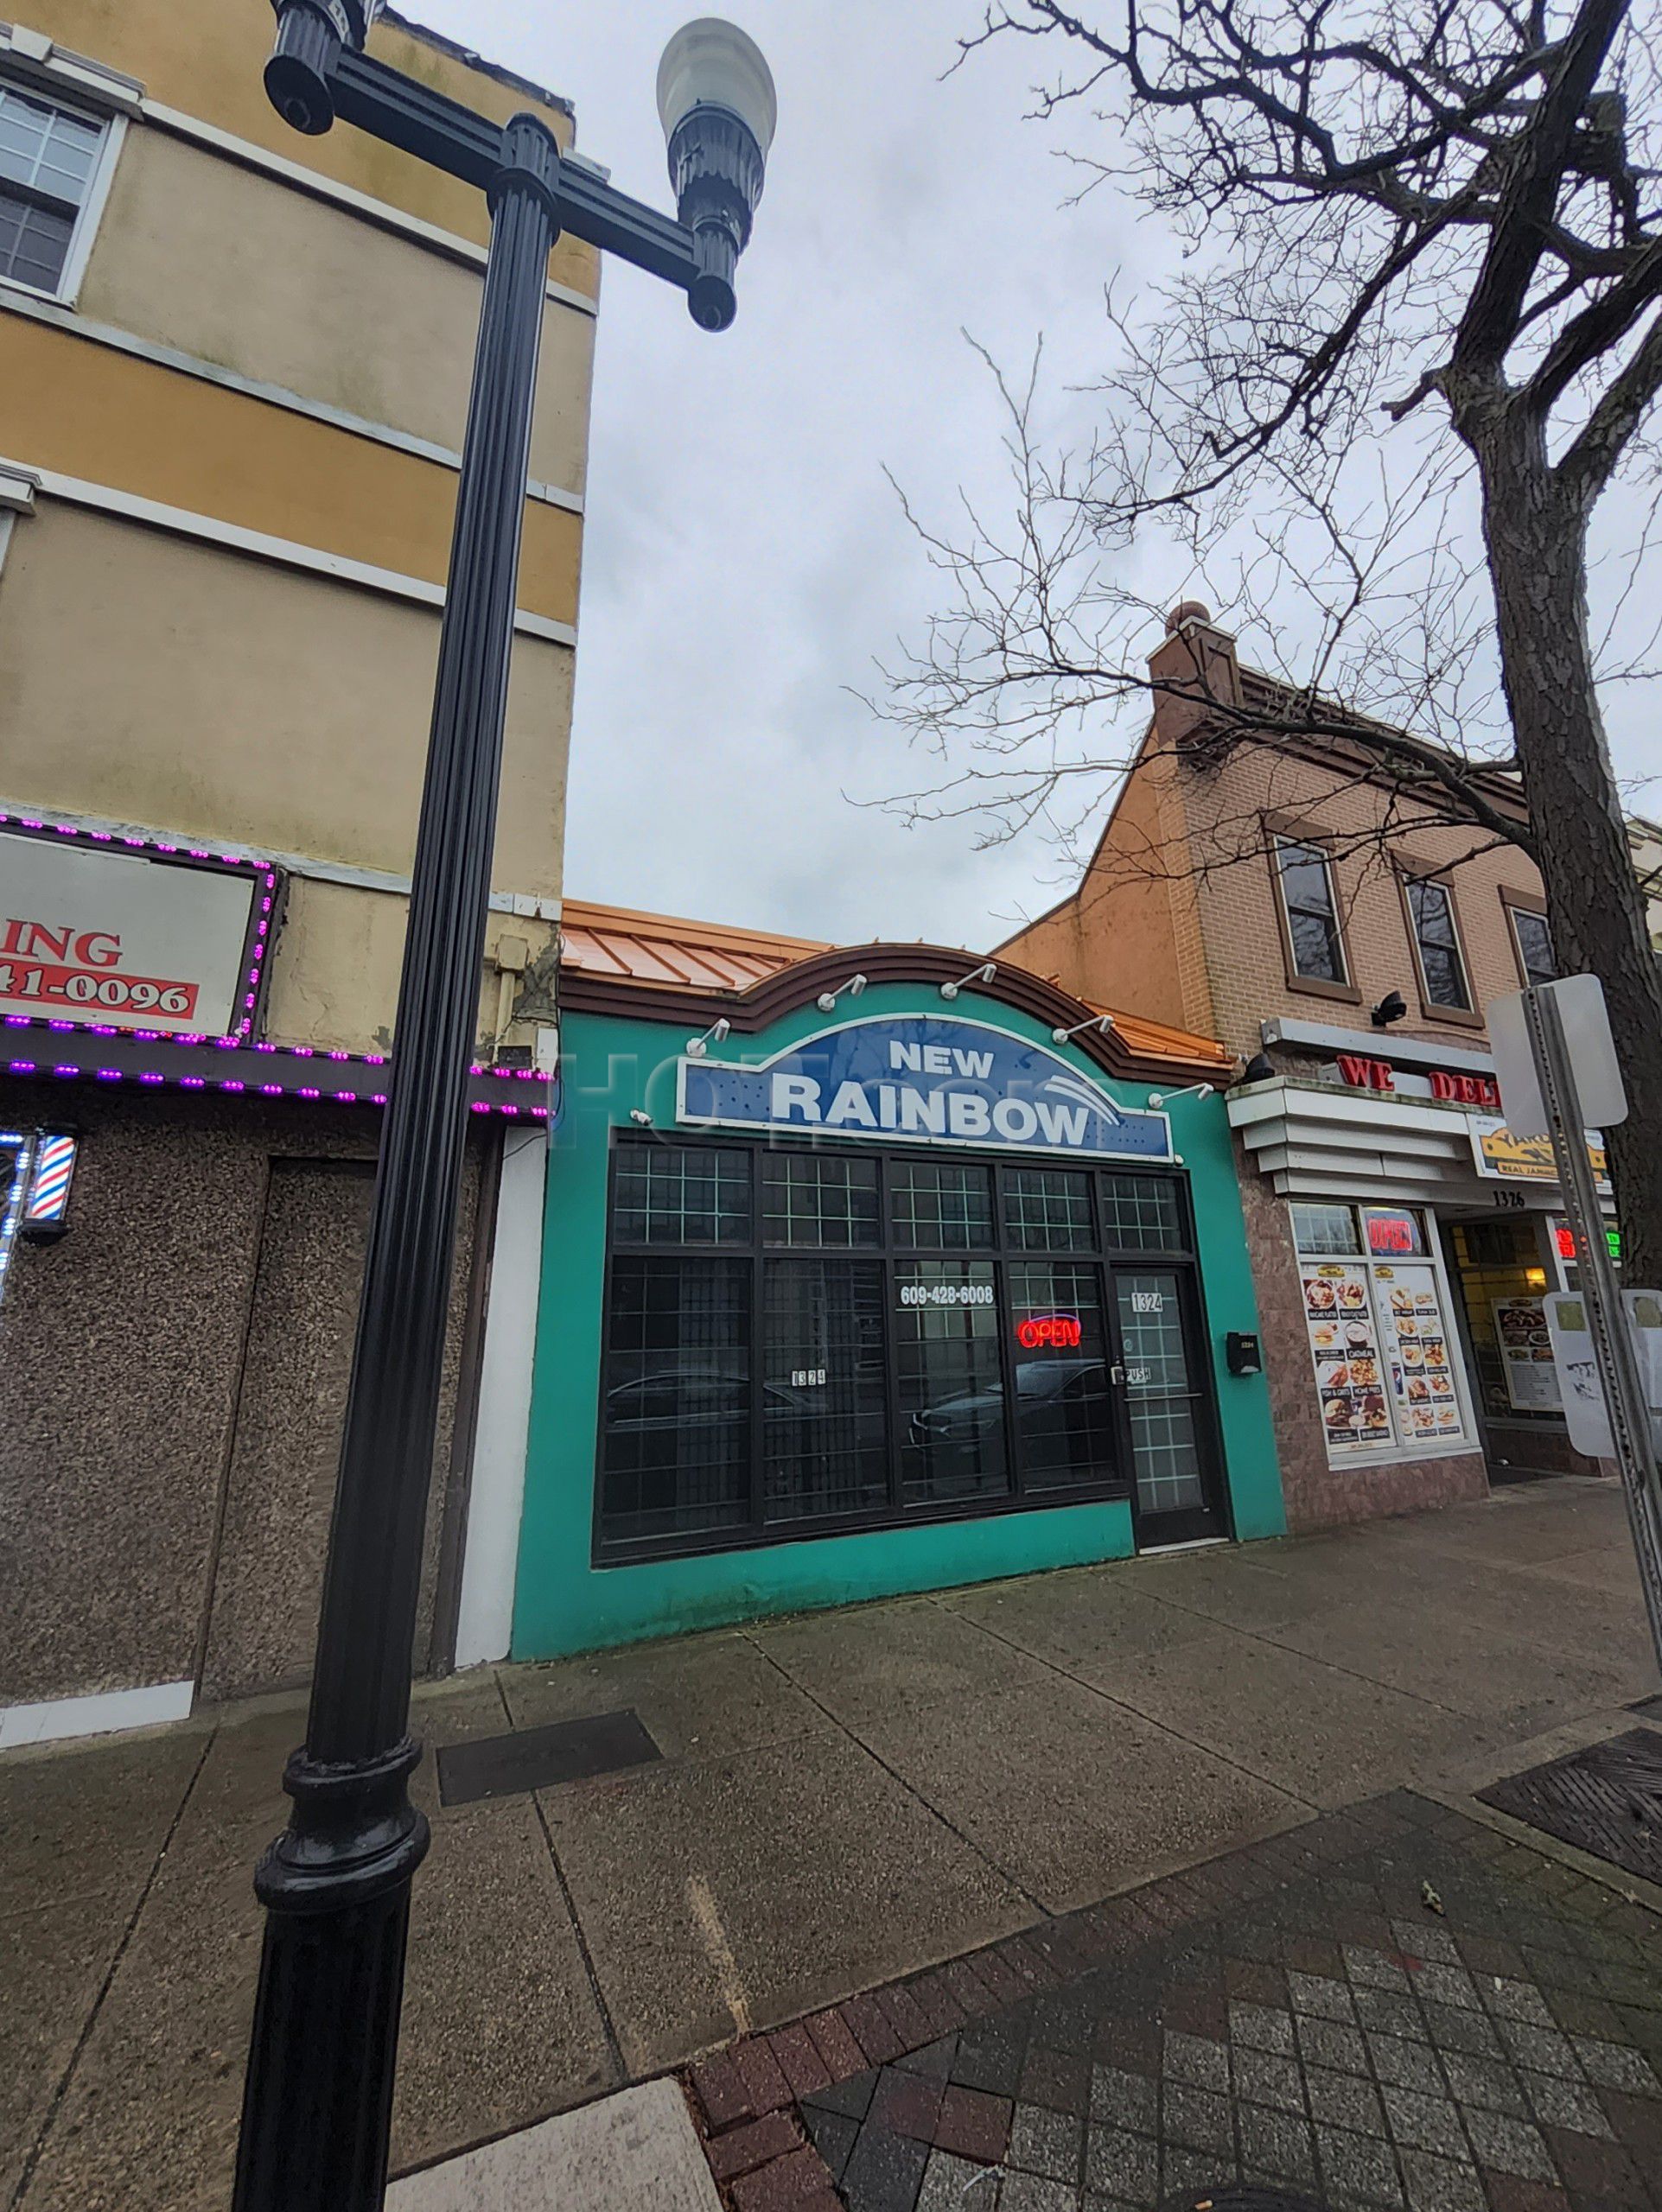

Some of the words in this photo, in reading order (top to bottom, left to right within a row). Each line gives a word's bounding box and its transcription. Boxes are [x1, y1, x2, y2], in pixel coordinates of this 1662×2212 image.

[0, 918, 123, 967] ING
[889, 1040, 994, 1079] NEW
[1337, 1054, 1395, 1091] WE
[1429, 1071, 1502, 1108] DEL
[772, 1072, 1090, 1146] RAINBOW
[1493, 1190, 1525, 1208] 1326
[901, 1286, 994, 1305] 609-428-6008
[1133, 1294, 1162, 1312] 1324
[1018, 1319, 1080, 1348] OPEN
[793, 1370, 825, 1385] 1324
[1126, 1368, 1151, 1380] PUSH
